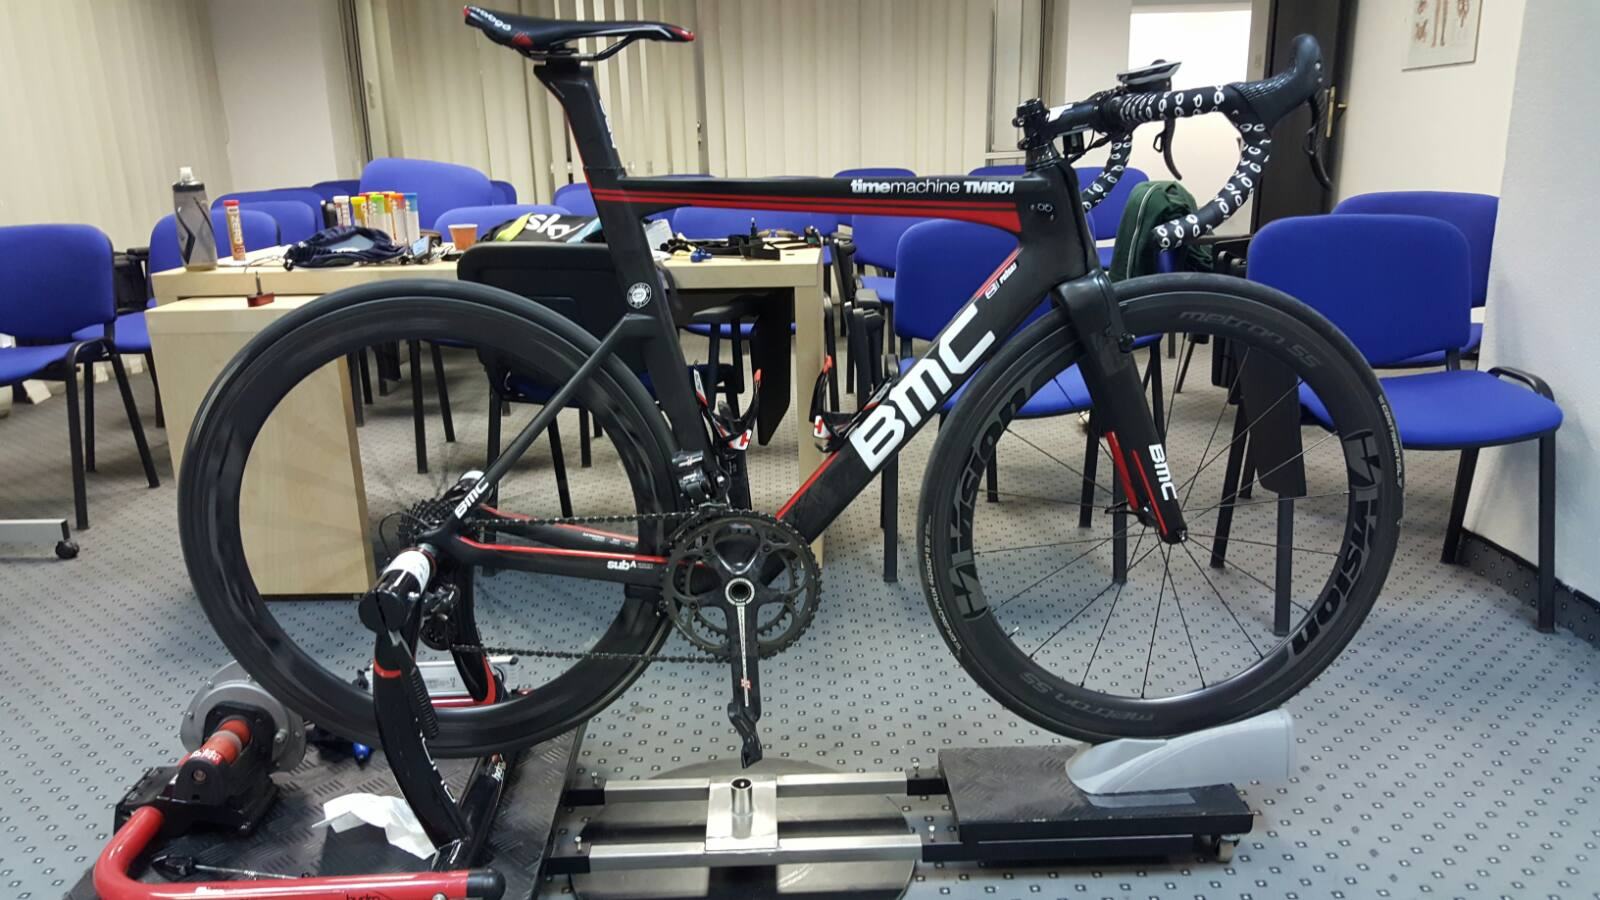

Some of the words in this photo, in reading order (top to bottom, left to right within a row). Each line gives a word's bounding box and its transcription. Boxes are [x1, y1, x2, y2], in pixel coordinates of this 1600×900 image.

[850, 179, 960, 194] timemachine
[963, 181, 1015, 194] TMR01
[849, 302, 996, 473] BMC
[1148, 443, 1178, 501] BMC
[454, 476, 489, 519] BMC
